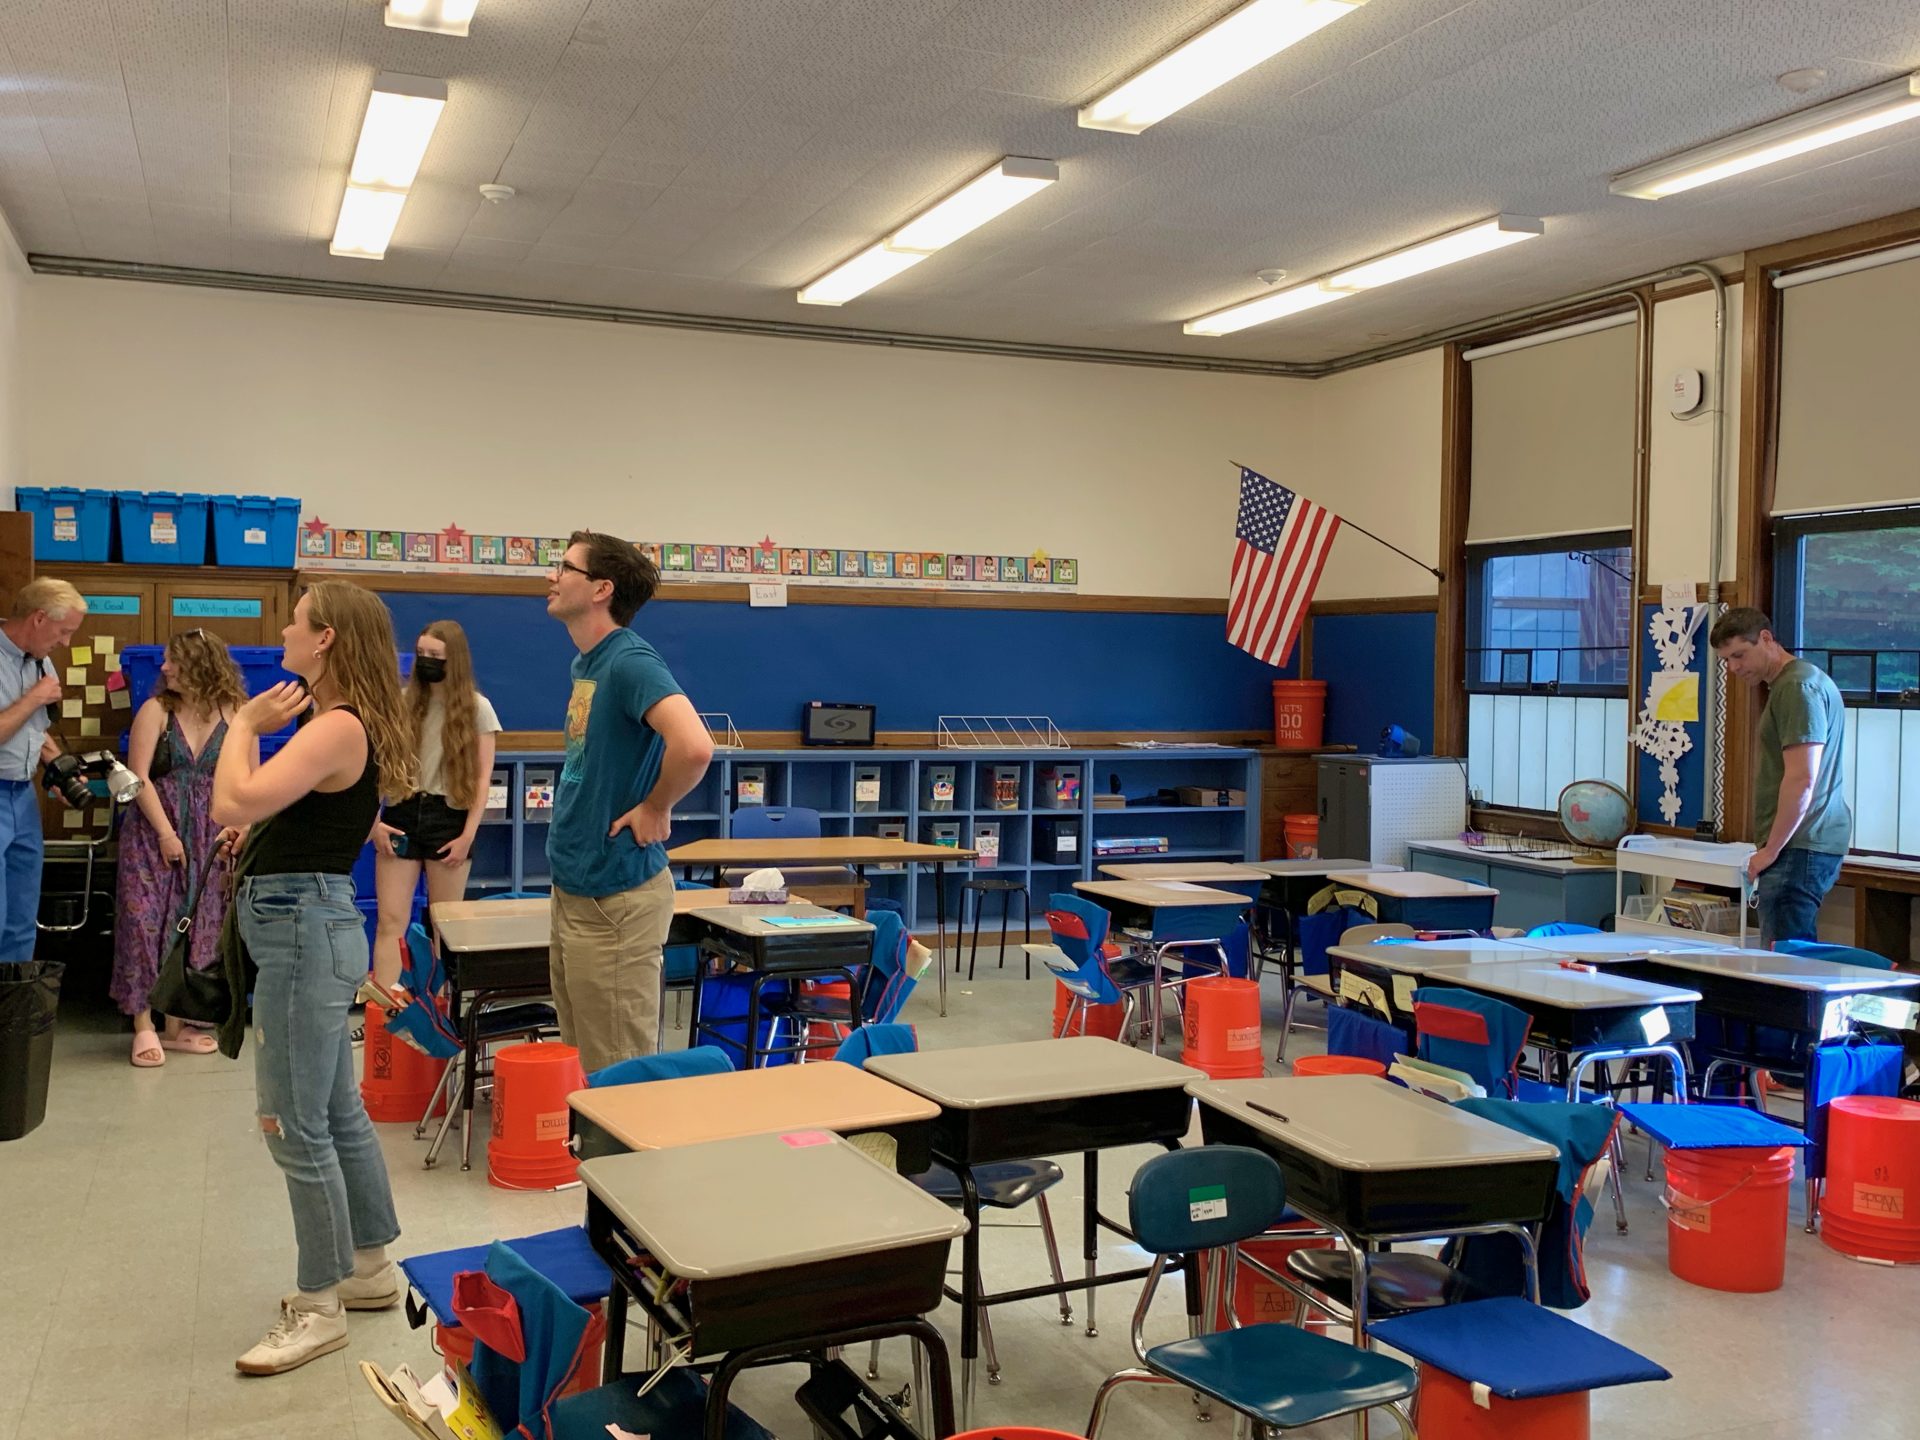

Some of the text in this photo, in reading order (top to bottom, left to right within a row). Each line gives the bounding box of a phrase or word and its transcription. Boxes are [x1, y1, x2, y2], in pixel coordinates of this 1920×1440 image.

[755, 585, 777, 600] East
[104, 601, 124, 611] Goal
[179, 603, 251, 614] My Writing Goal
[1280, 713, 1302, 729] DO
[1859, 1191, 1901, 1213] Wade
